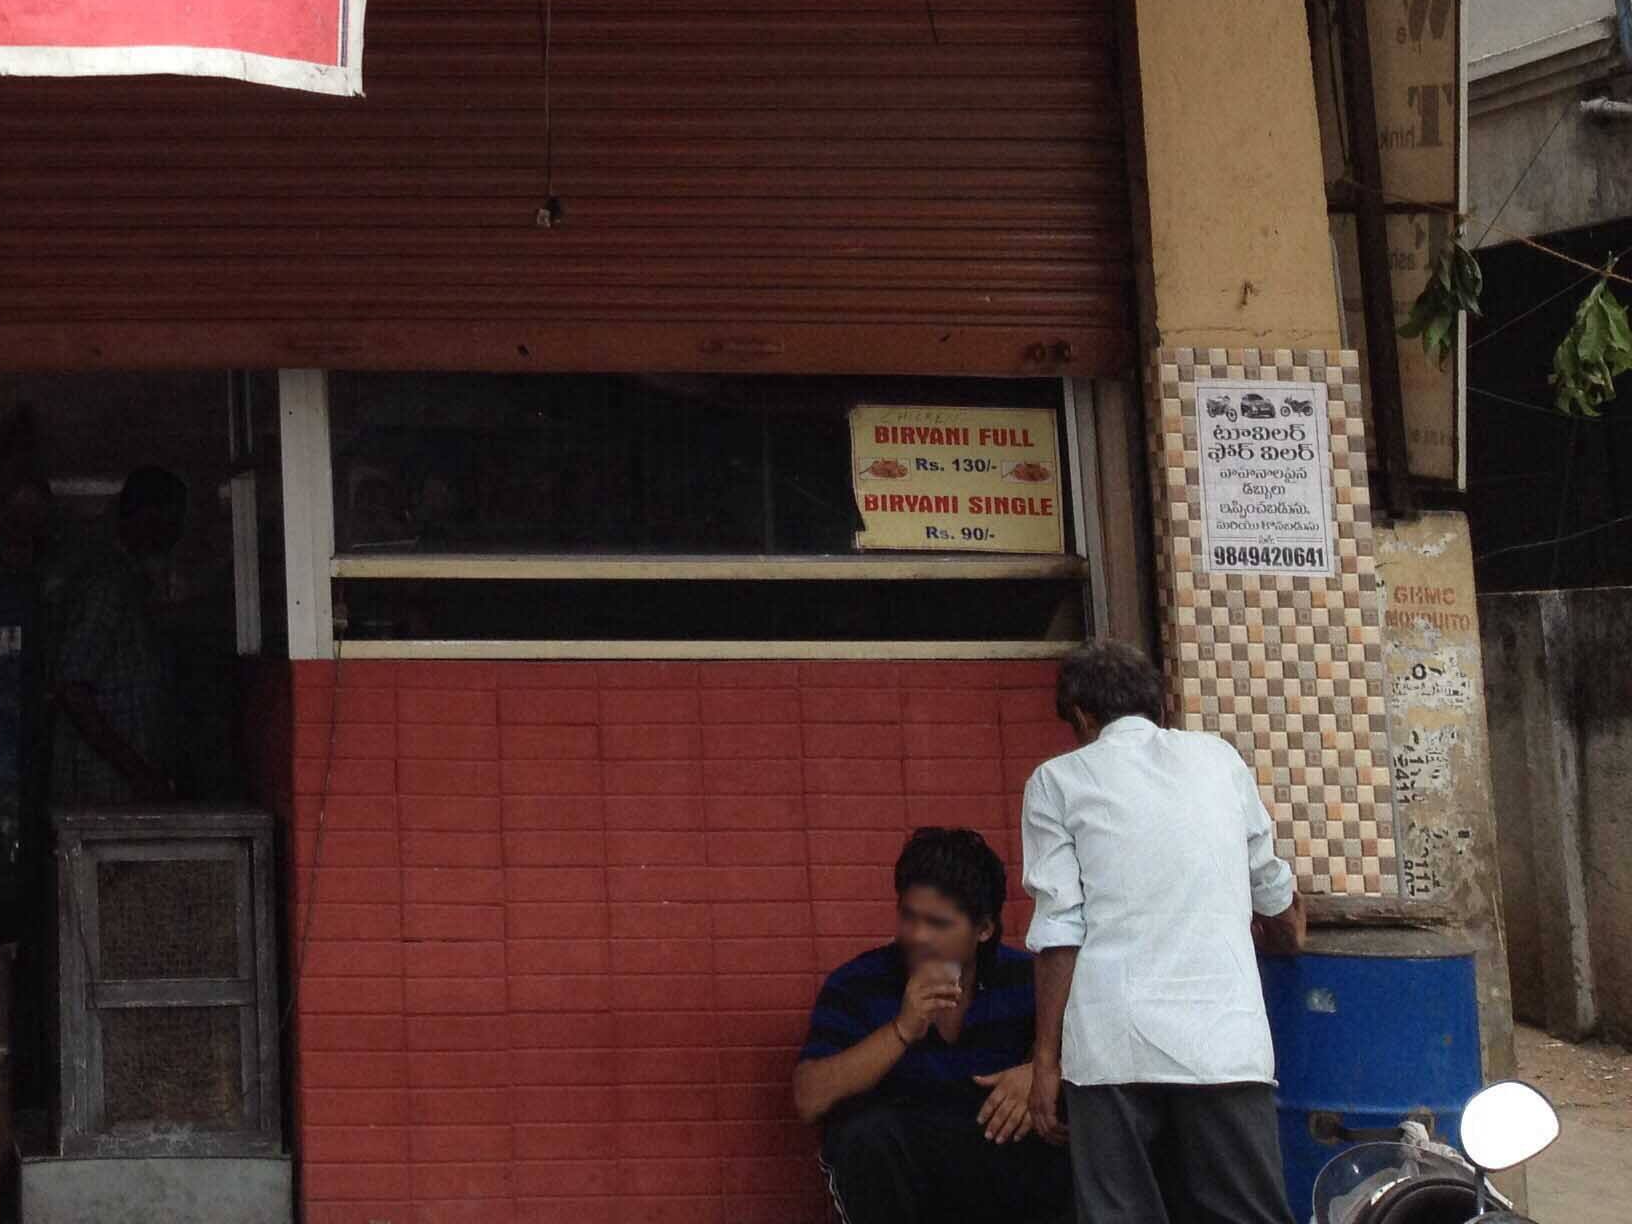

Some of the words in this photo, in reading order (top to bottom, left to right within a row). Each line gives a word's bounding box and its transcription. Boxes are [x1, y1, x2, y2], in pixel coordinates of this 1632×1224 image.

[874, 425, 969, 446] BIRYANI
[979, 427, 1035, 447] FULL
[915, 457, 945, 472] Rs.
[951, 458, 998, 474] 130/-
[864, 494, 959, 514] BIRYANI
[968, 495, 1054, 516] SINGLE
[925, 526, 956, 541] Rs.
[961, 527, 996, 542] 90/-
[1213, 546, 1325, 568] 9849420641
[1393, 584, 1457, 606] GHMC
